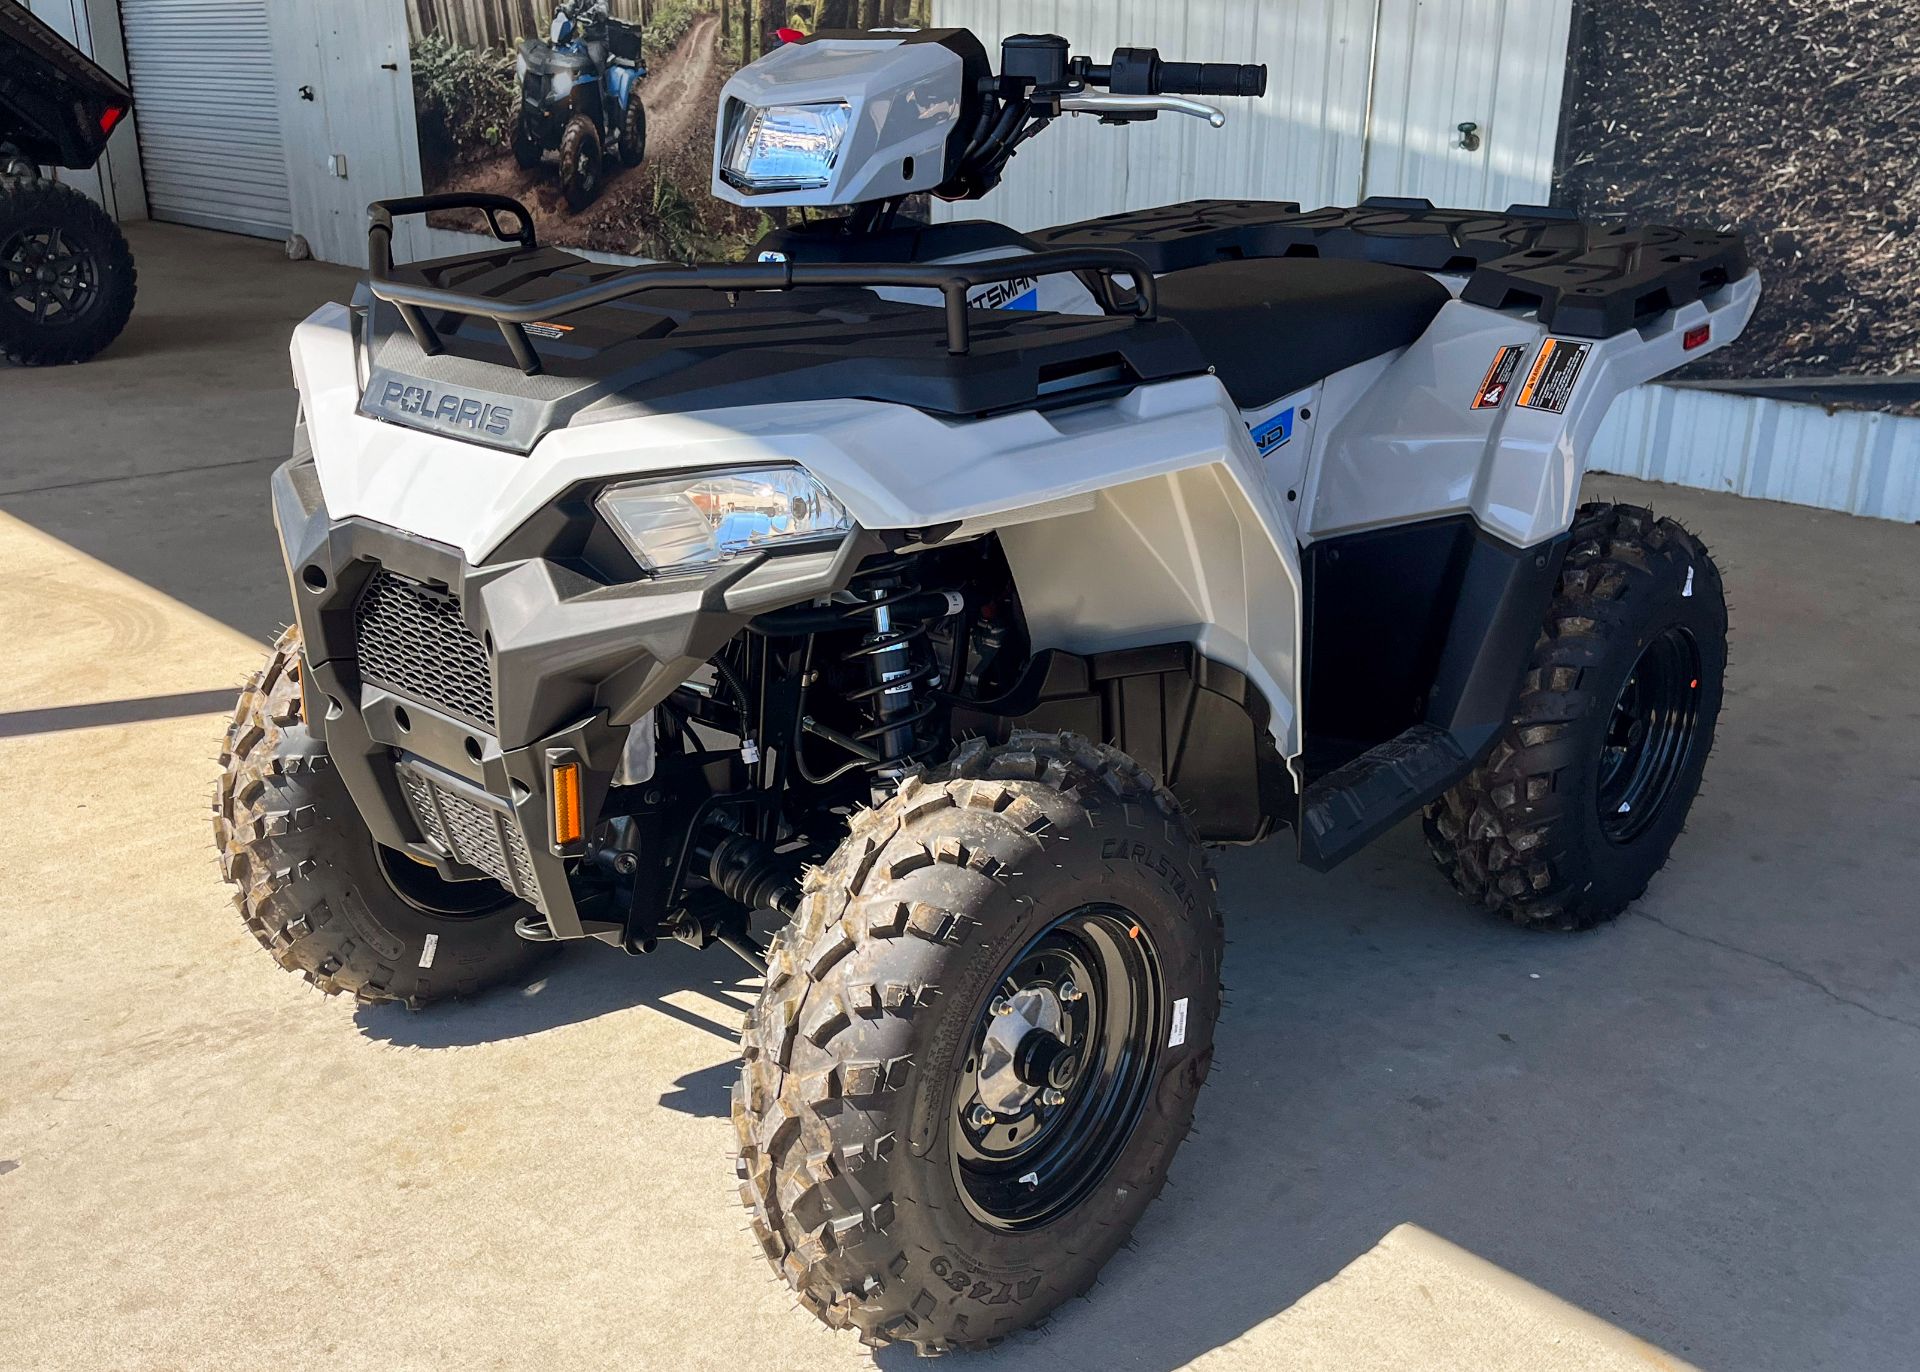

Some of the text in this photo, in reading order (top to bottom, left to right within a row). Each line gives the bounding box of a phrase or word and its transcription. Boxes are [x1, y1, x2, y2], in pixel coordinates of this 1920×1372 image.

[1531, 354, 1547, 381] WARNING
[380, 381, 513, 436] POLARIS
[1100, 838, 1197, 921] CARLSTAR
[929, 1254, 1042, 1306] AT489
